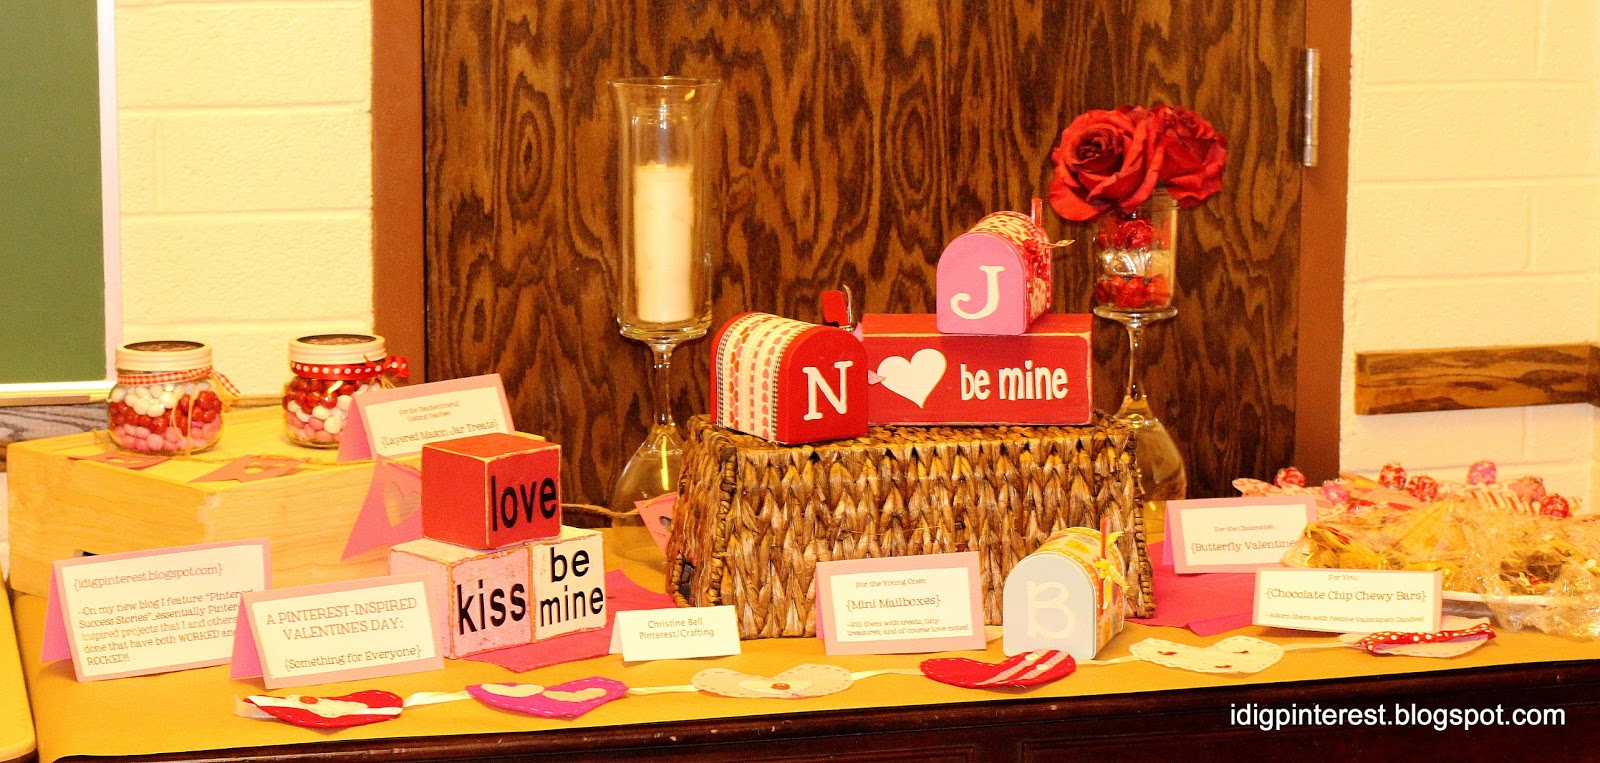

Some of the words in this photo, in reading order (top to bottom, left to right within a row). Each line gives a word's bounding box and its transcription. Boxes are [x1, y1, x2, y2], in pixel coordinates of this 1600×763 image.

[950, 265, 1005, 320] J
[802, 360, 854, 421] N
[960, 363, 991, 401] be
[999, 359, 1069, 401] mine
[420, 429, 447, 440] Mason
[450, 425, 465, 436] Jar
[490, 475, 557, 532] love
[550, 547, 590, 583] be
[855, 580, 868, 589] For
[869, 579, 882, 587] the
[882, 578, 907, 588] Young
[1327, 590, 1354, 602] Chip
[1355, 591, 1394, 603] Chewy
[98, 605, 115, 616] my
[116, 602, 137, 612] new
[138, 598, 160, 610] blog
[167, 595, 203, 607] feature
[266, 614, 275, 625] A
[278, 597, 418, 624] PINTEREST-INSPIRED
[456, 579, 526, 636] kiss
[539, 585, 604, 627] mine
[1025, 580, 1076, 640] B
[79, 616, 115, 629] Success
[121, 625, 159, 639] projects
[160, 621, 181, 632] that
[187, 618, 206, 629] and
[371, 617, 404, 631] DAY:
[639, 627, 715, 640] Pinterest/Crafting
[647, 618, 686, 629] Christine
[687, 617, 703, 626] Bell
[84, 643, 107, 654] done
[108, 641, 129, 652] that
[129, 638, 154, 650] have
[155, 634, 176, 646] both
[178, 629, 220, 642] WORKED
[285, 655, 346, 672] {Something
[347, 653, 363, 664] for
[365, 645, 422, 662] Everyone}
